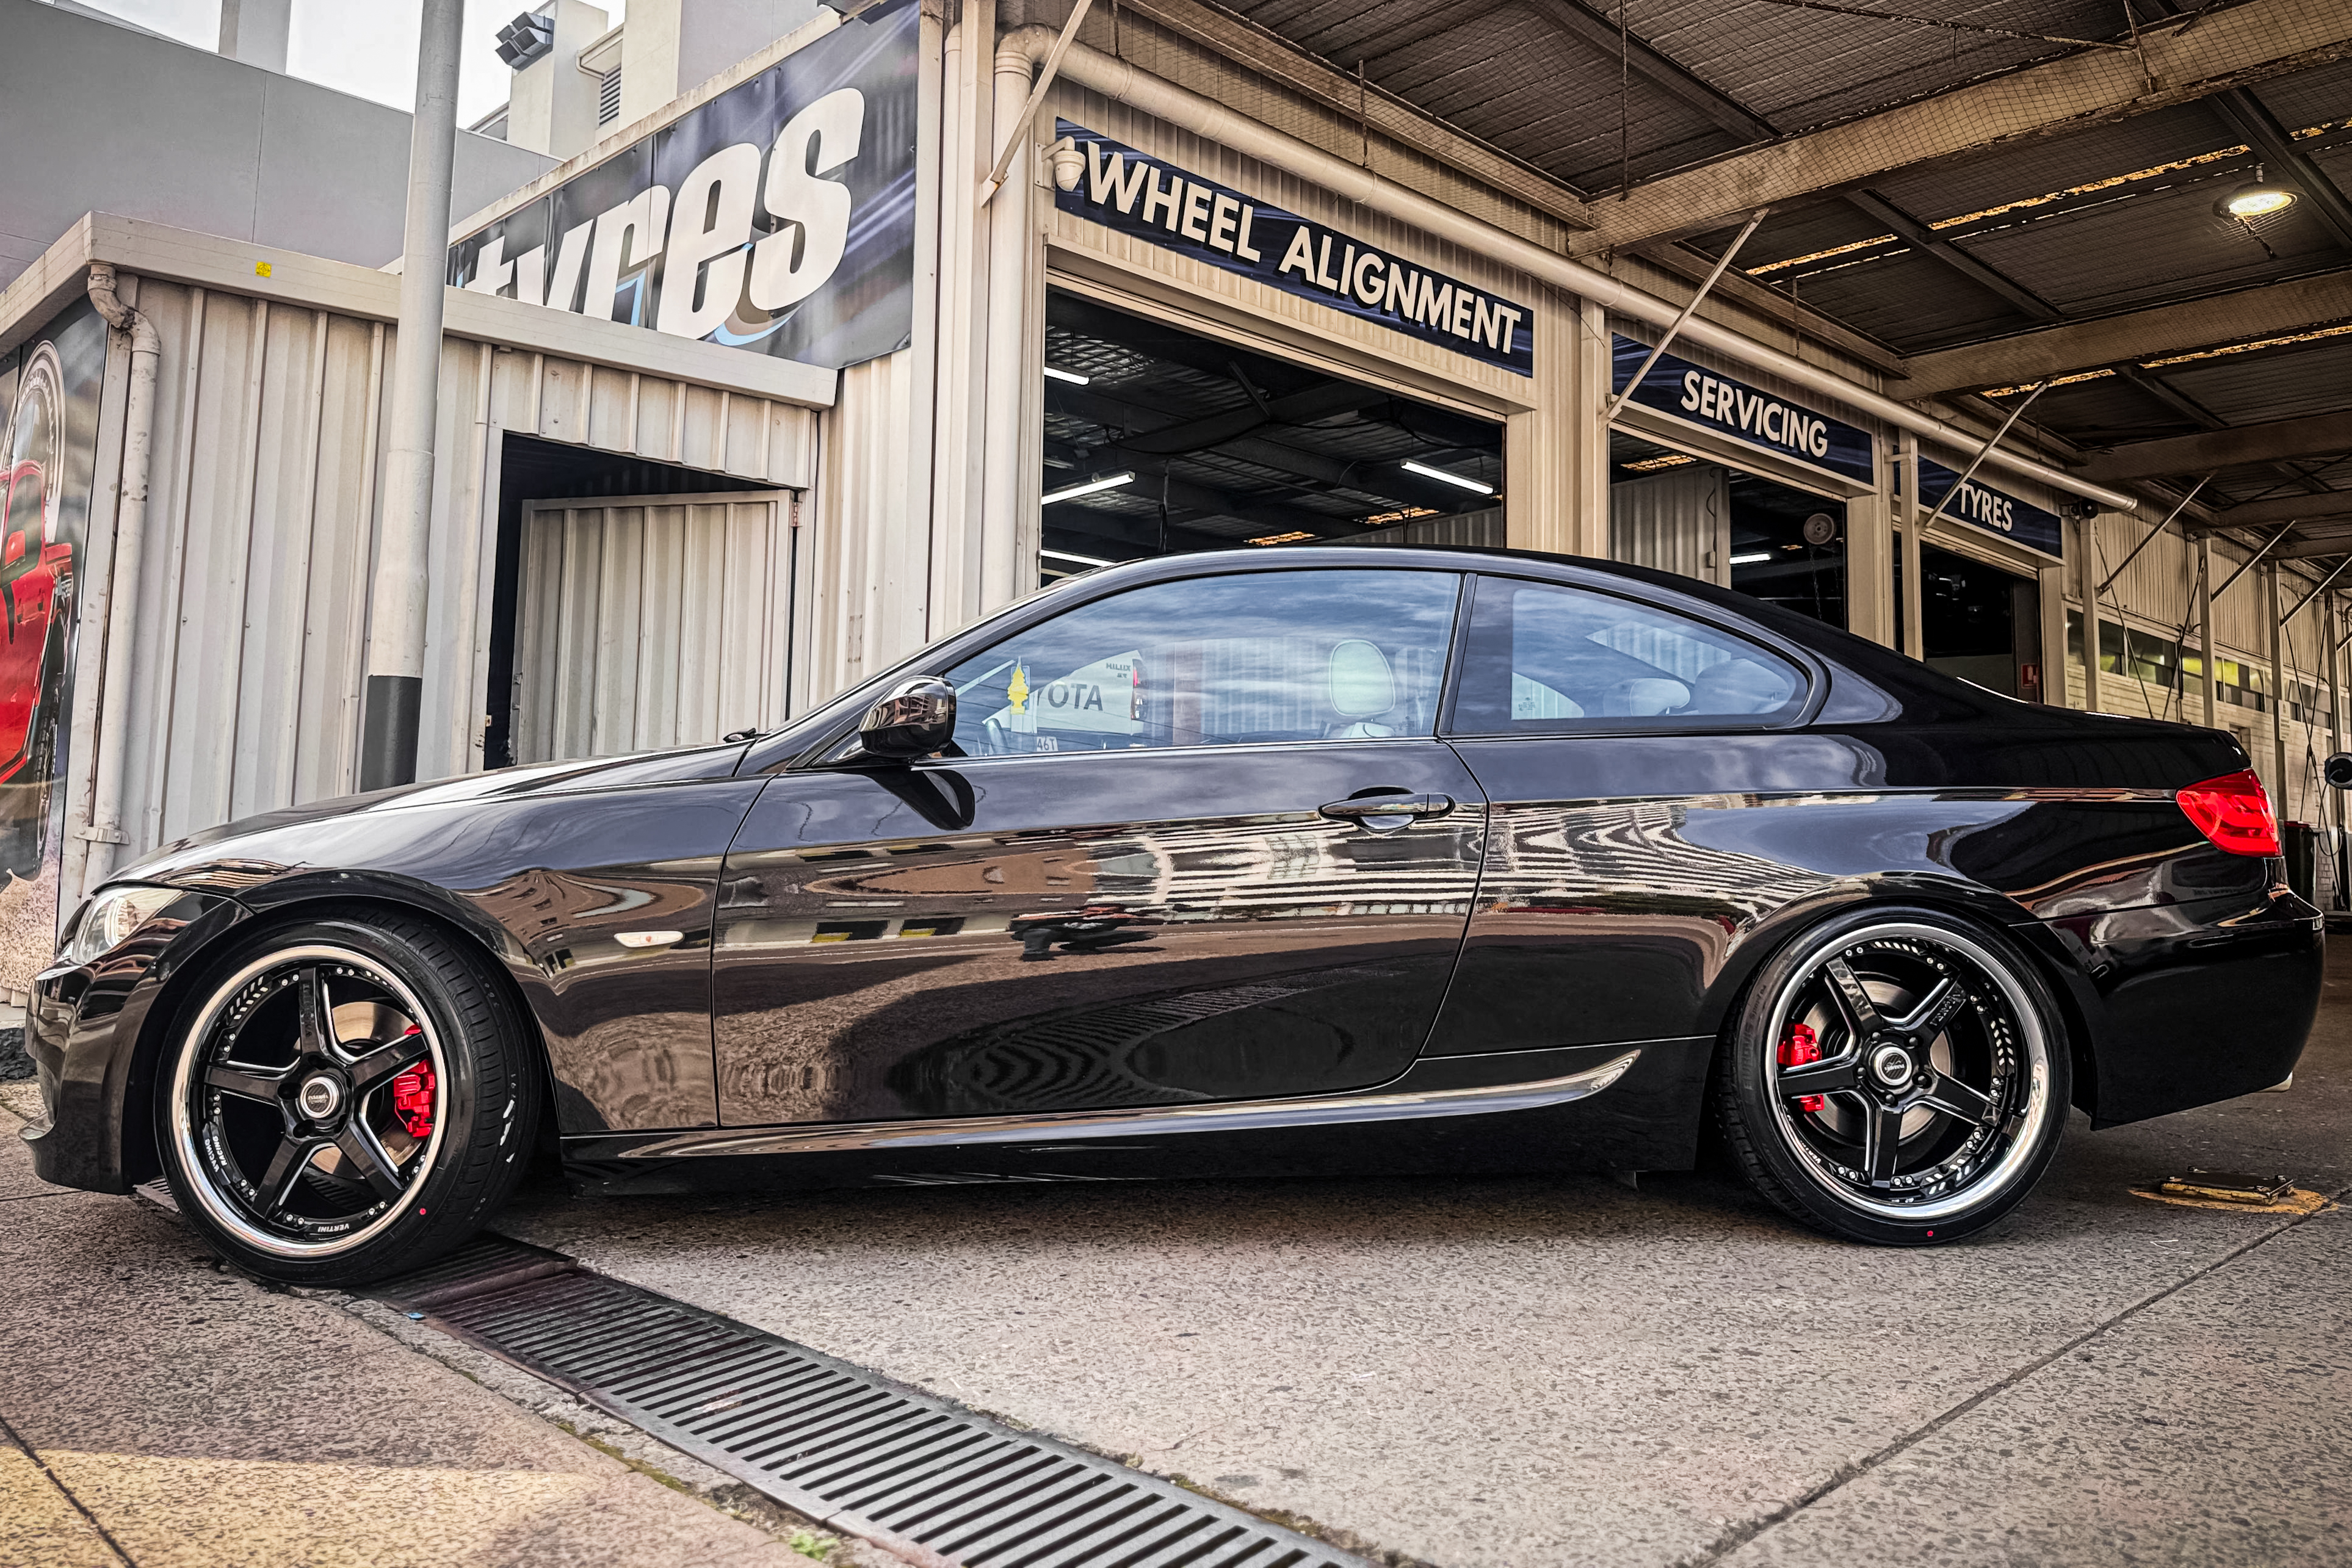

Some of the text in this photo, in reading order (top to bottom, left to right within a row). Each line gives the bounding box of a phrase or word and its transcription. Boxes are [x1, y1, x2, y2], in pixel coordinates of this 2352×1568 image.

[1087, 140, 1521, 355] WHEEL ALIGNMENT
[1680, 370, 1828, 458] SERVICING
[1958, 482, 2013, 532] TYRES
[212, 1135, 228, 1166] RACING
[317, 1223, 350, 1232] VERTINI
